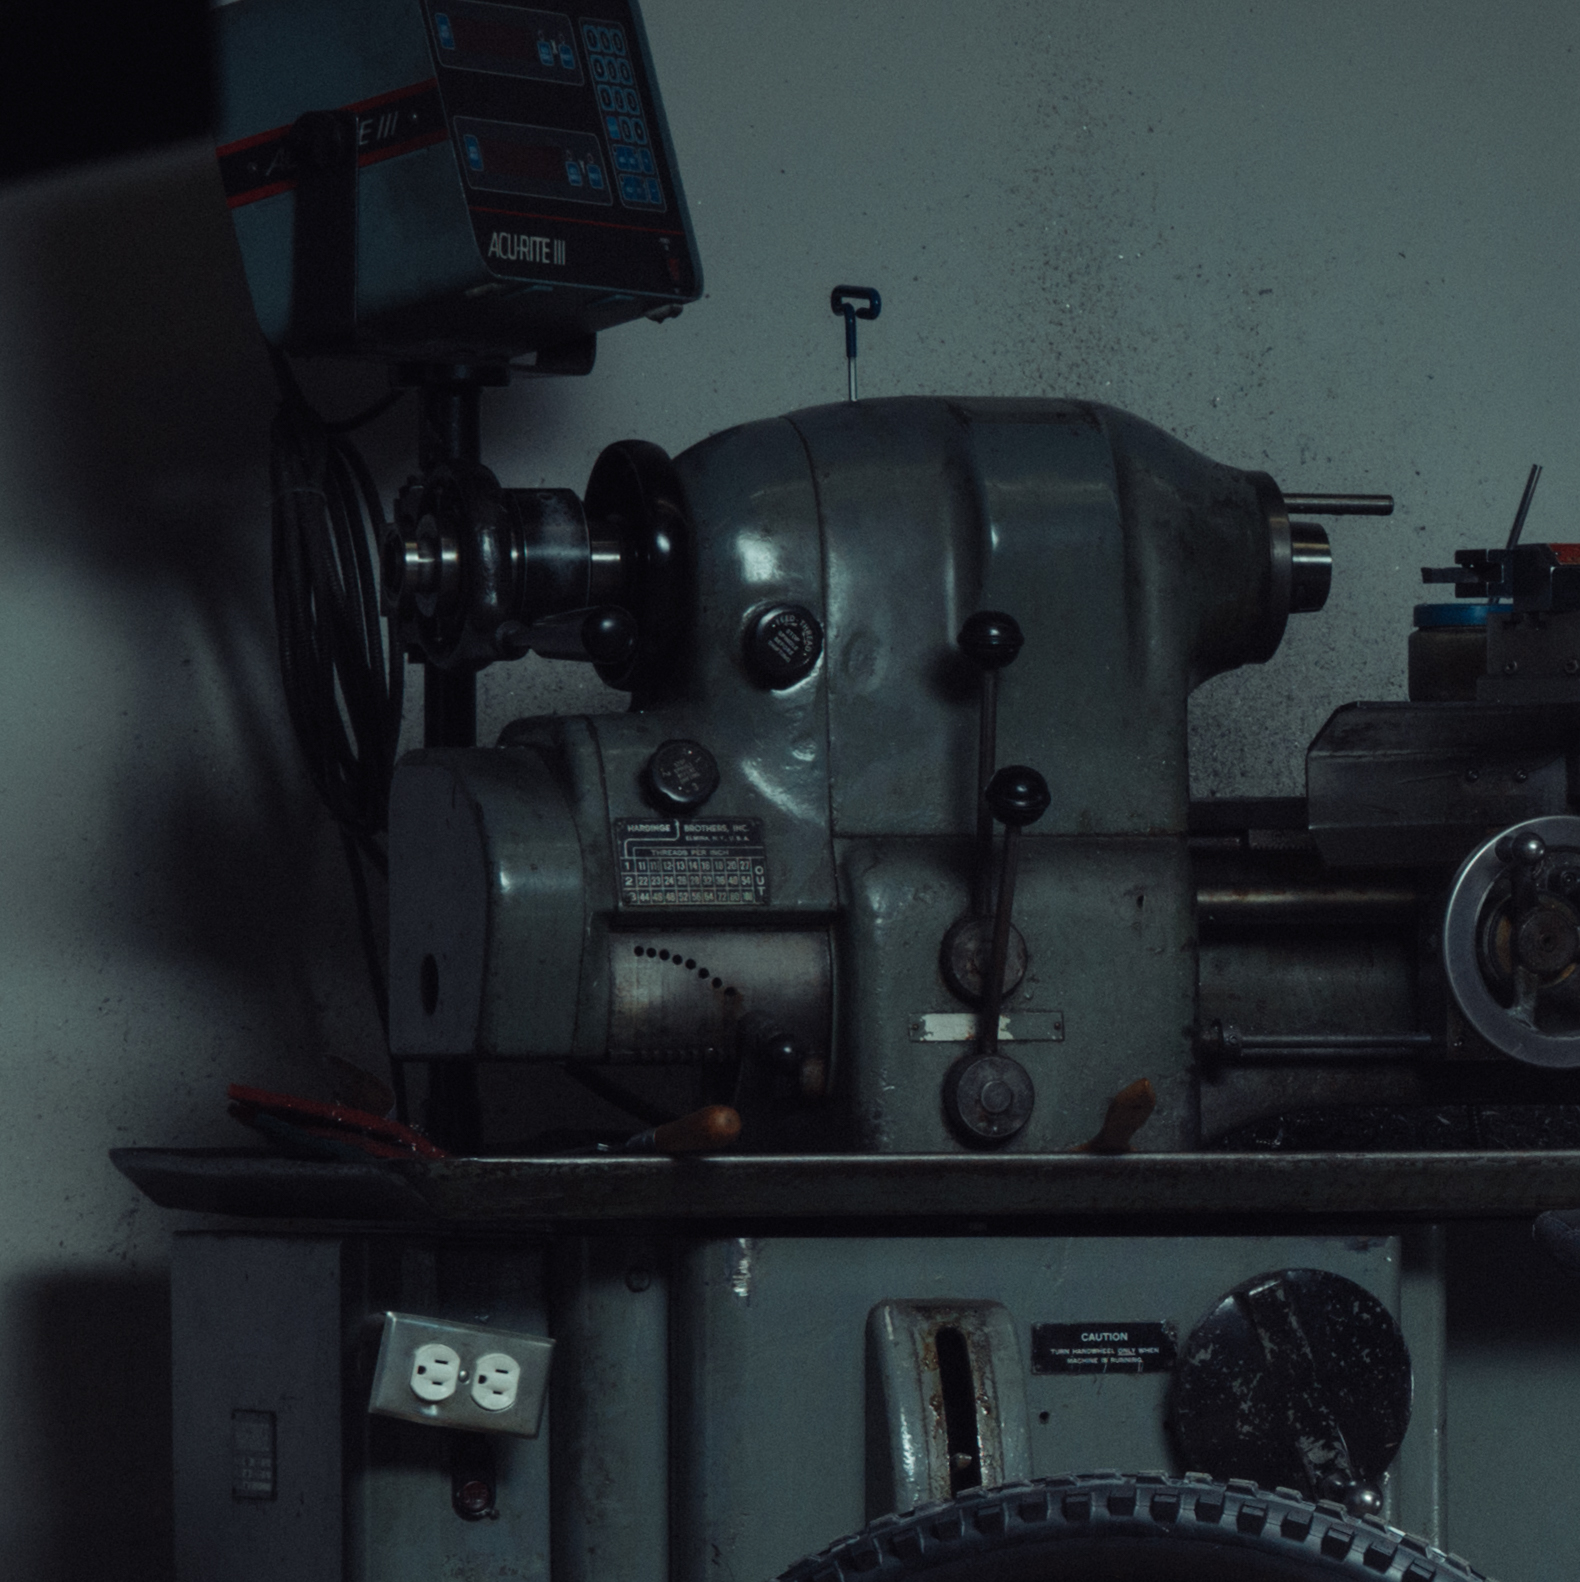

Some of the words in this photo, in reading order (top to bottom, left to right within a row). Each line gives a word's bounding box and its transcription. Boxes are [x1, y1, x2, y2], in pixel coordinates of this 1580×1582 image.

[627, 823, 671, 833] HARDINGE
[651, 848, 688, 856] THREADS
[690, 848, 706, 856] PER
[1081, 1332, 1128, 1342] CAUTION
